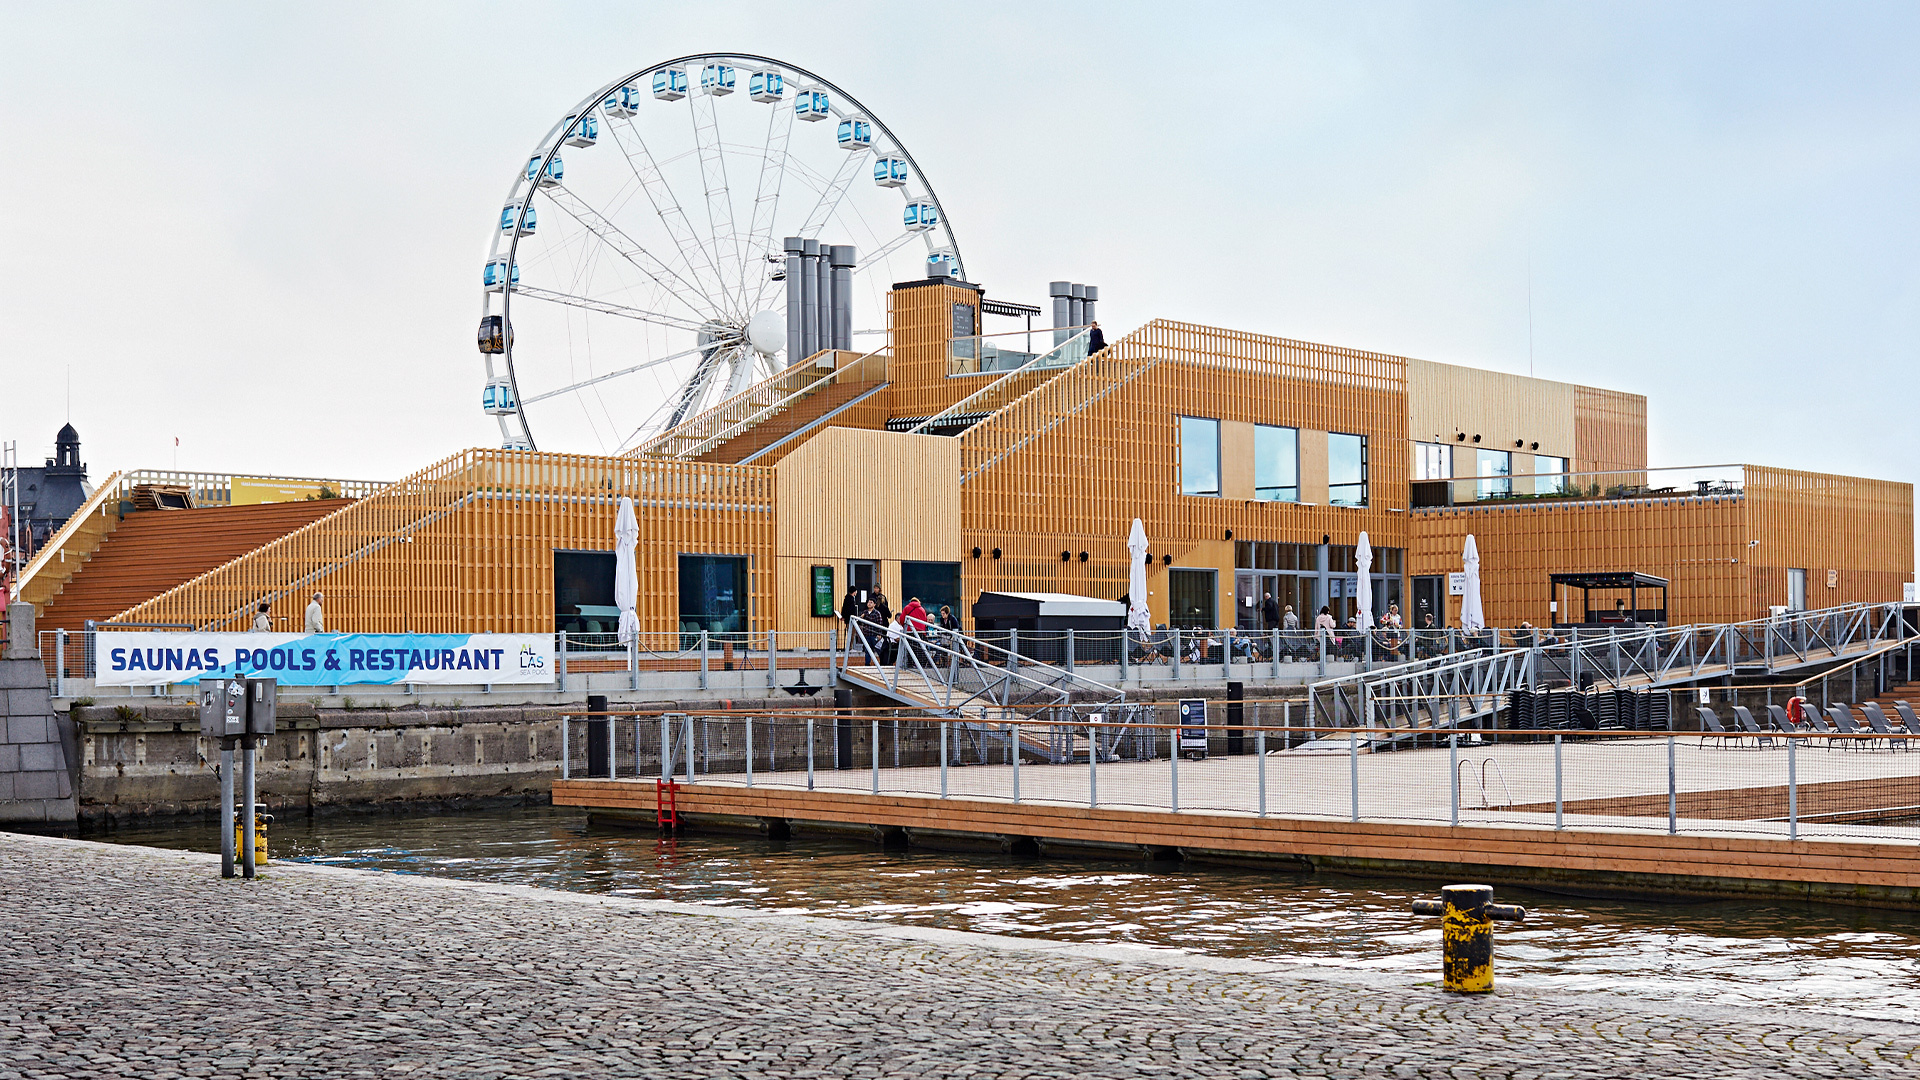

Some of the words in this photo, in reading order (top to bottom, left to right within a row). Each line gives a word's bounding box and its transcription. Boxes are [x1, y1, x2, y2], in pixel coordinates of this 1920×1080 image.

[520, 644, 536, 656] AL
[110, 648, 227, 673] SAUNAS,
[235, 648, 316, 671] POOLS
[323, 648, 342, 671] &
[349, 648, 505, 671] RESTAURANT
[520, 656, 544, 668] LAS
